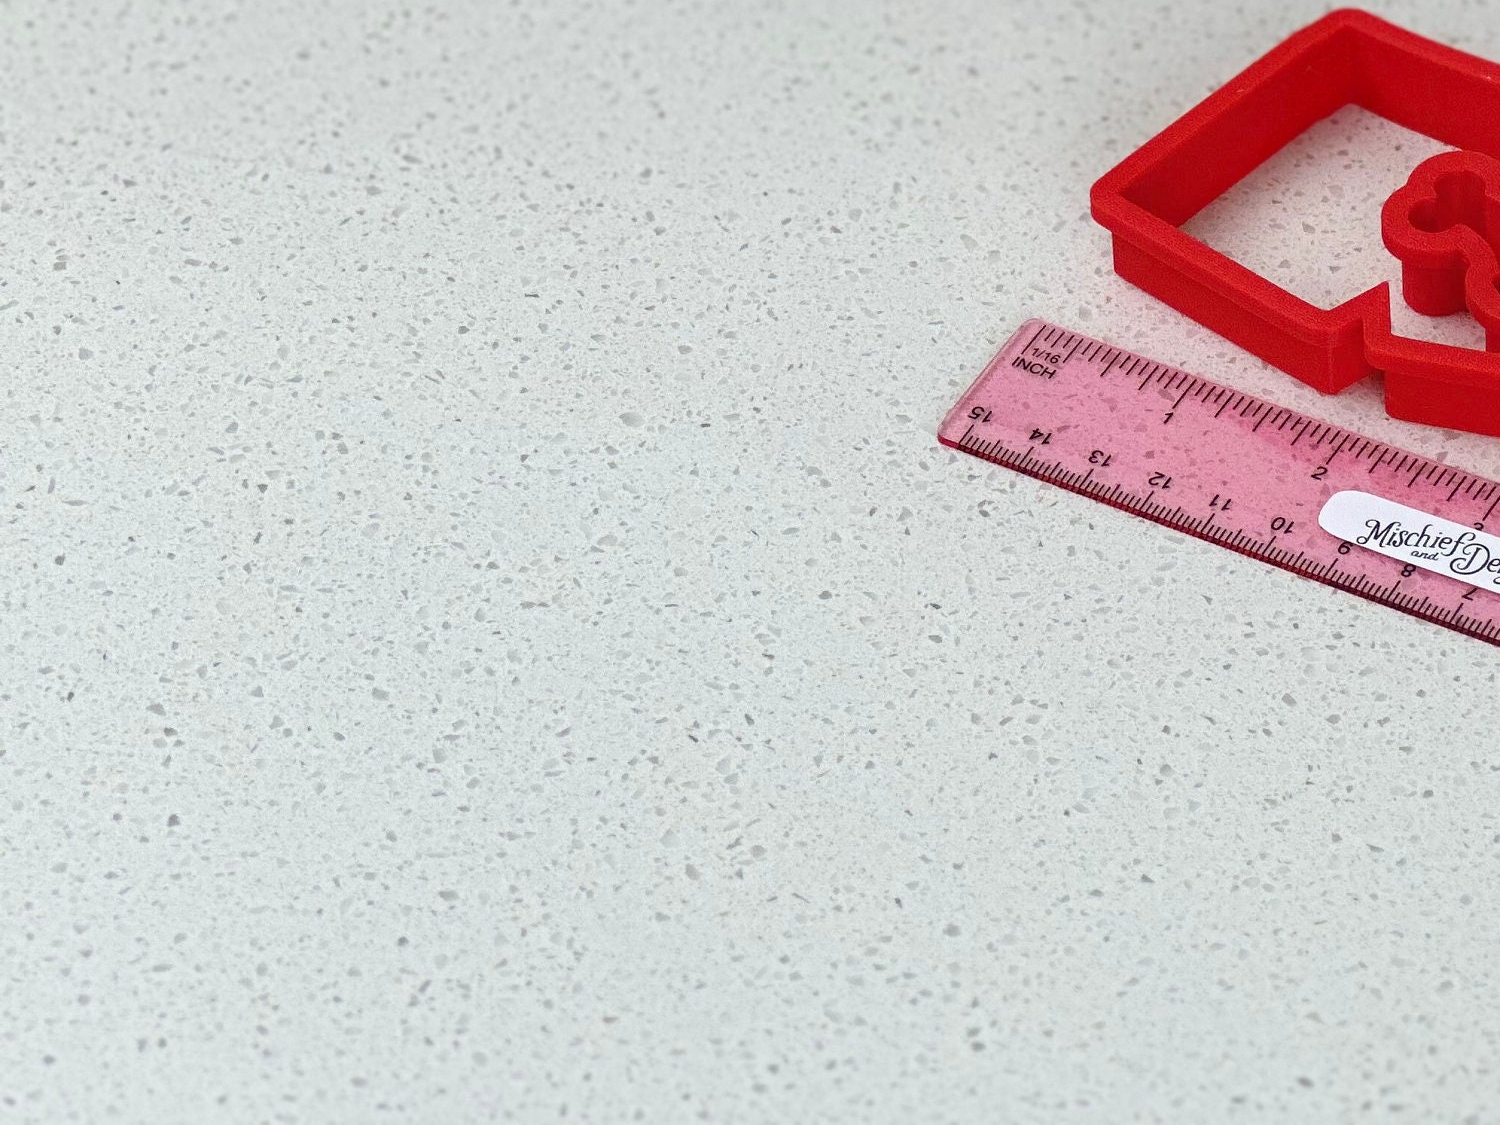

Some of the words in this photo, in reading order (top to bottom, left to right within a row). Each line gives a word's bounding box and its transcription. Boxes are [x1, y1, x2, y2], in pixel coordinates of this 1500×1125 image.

[1012, 356, 1057, 379] INCH
[1032, 347, 1060, 364] 1/16
[1163, 411, 1174, 424] 1
[1311, 466, 1328, 481] 2
[967, 406, 993, 423] 15
[1029, 428, 1053, 445] 14
[1089, 450, 1112, 467] 13
[1148, 472, 1174, 489] 12
[1208, 494, 1233, 511] 11
[1270, 517, 1294, 534] 10
[1356, 519, 1476, 556] Mischief
[1410, 550, 1439, 562] and
